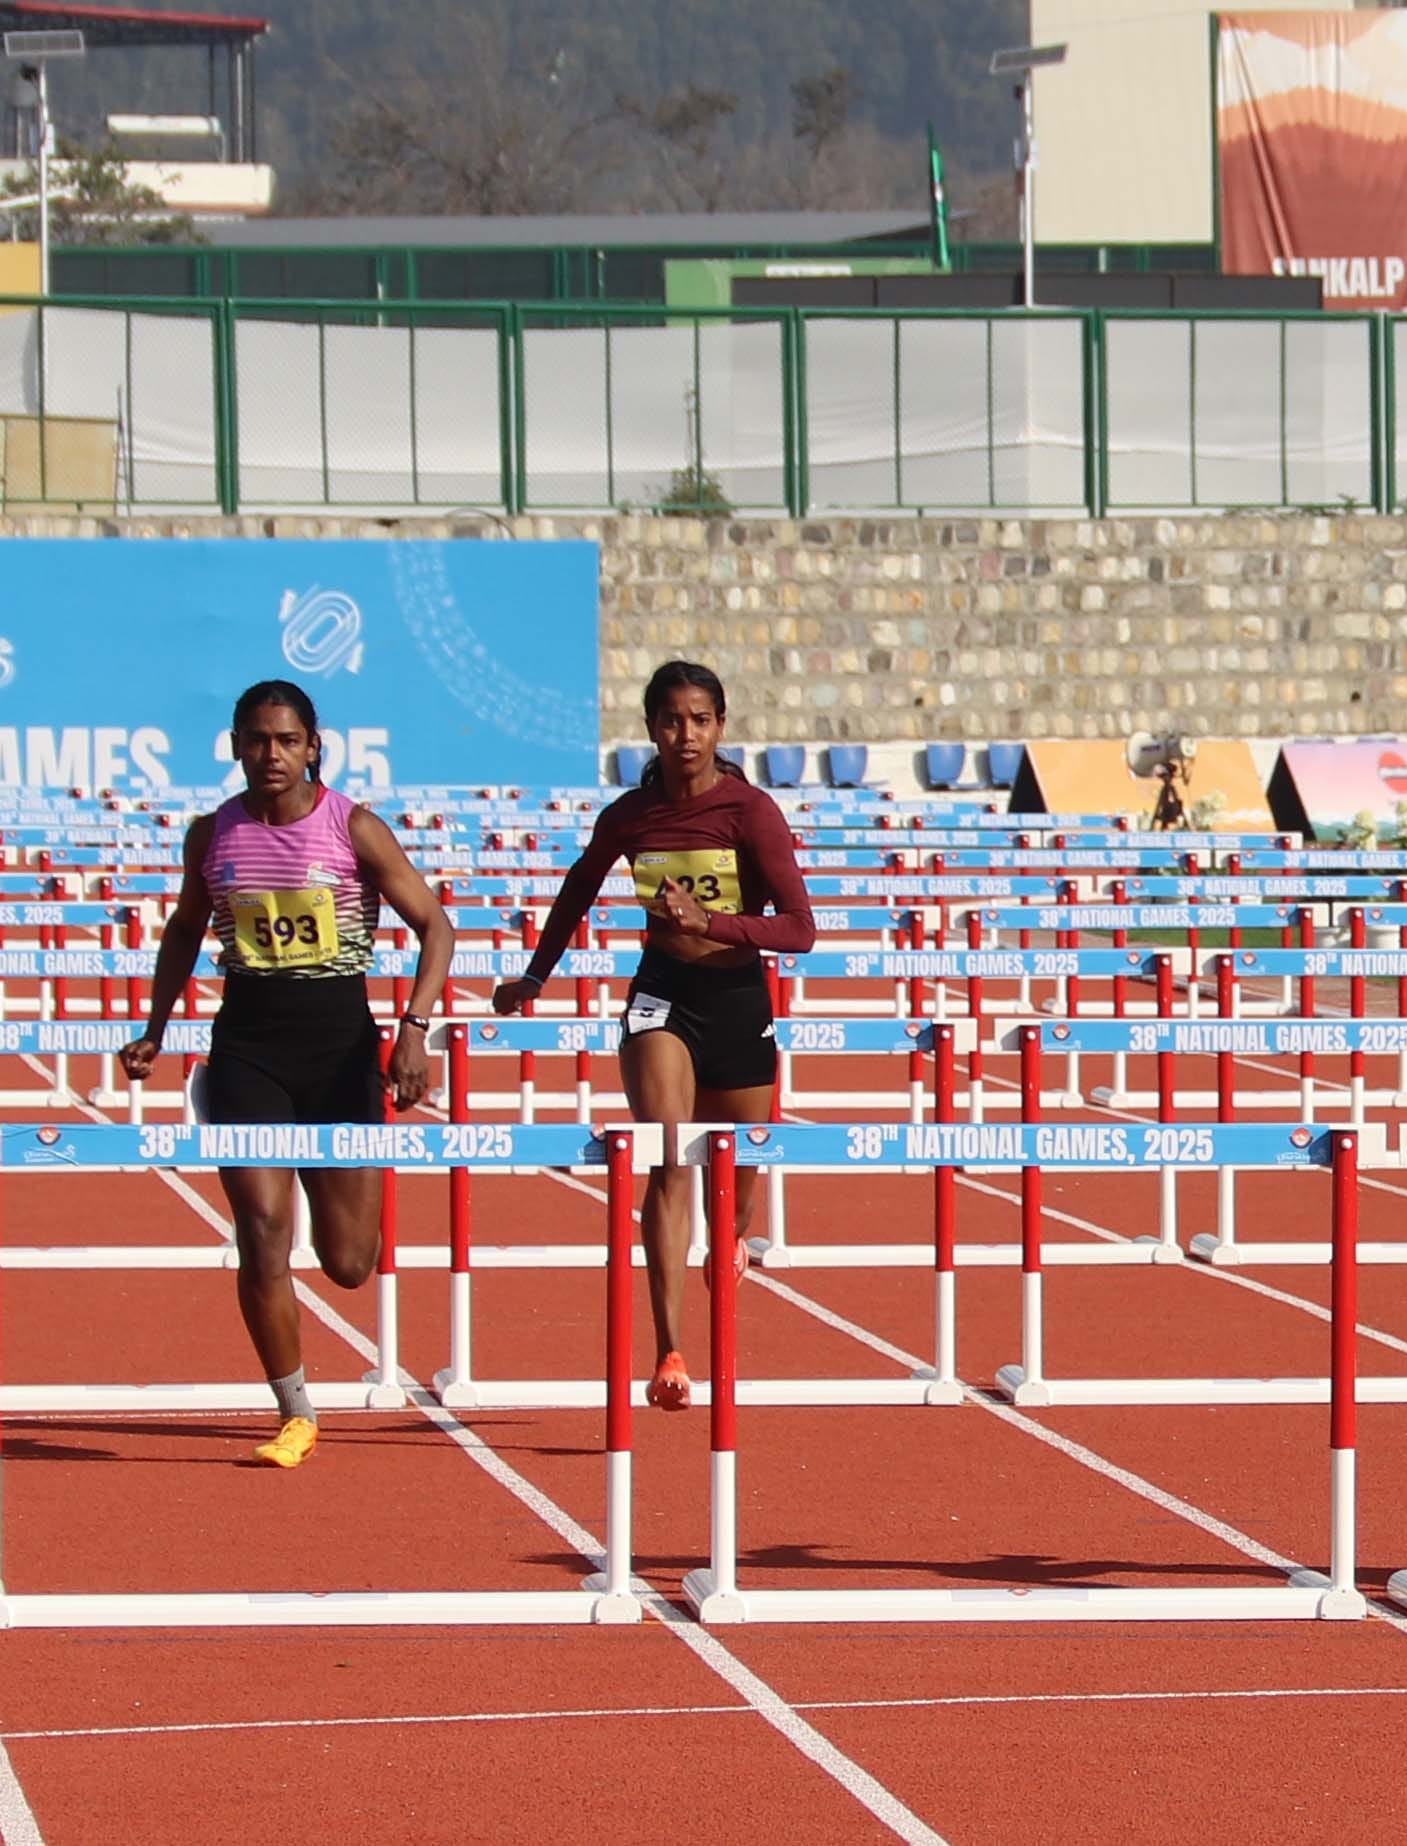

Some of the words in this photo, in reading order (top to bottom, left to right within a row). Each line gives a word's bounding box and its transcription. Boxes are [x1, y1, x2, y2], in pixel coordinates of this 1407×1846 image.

[840, 880, 865, 895] 38TH
[868, 880, 925, 895] NATIONAL
[929, 880, 975, 896] GAMES,
[979, 880, 1011, 895] 2025
[1178, 879, 1202, 895] 38TH
[1204, 879, 1262, 895] NATIONAL
[1265, 879, 1311, 896] GAMES,
[1314, 879, 1347, 895] 2025
[24, 905, 63, 925] 2025
[1039, 909, 1068, 927] 38TH
[1071, 909, 1136, 927] NATIONAL
[1140, 909, 1194, 928] GAMES,
[1198, 909, 1236, 927] 2025
[254, 915, 319, 948] 593
[44, 953, 109, 976] GAMES,
[113, 953, 157, 974] 2025
[379, 953, 413, 975] 38TH
[569, 953, 615, 975] 2025
[846, 954, 879, 975] 38TH
[884, 954, 960, 975] NATIONAL
[966, 954, 1030, 977] GAMES,
[1035, 954, 1079, 975] 2025
[1304, 953, 1338, 974] 38TH
[39, 1022, 133, 1050] NATIONAL
[558, 1024, 598, 1050] 38TH
[790, 1024, 845, 1050] 2025
[1130, 1025, 1170, 1051] 38TH
[1175, 1025, 1270, 1051] NATIONAL
[1277, 1025, 1352, 1053] GAMES,
[139, 1125, 193, 1159] 38TH
[201, 1125, 325, 1159] NATIONAL
[332, 1125, 435, 1162] GAMES,
[442, 1125, 513, 1159] 2025
[846, 1126, 898, 1161] 38TH
[906, 1126, 1028, 1161] NATIONAL
[1036, 1126, 1136, 1164] GAMES,
[1144, 1126, 1214, 1161] 2025
